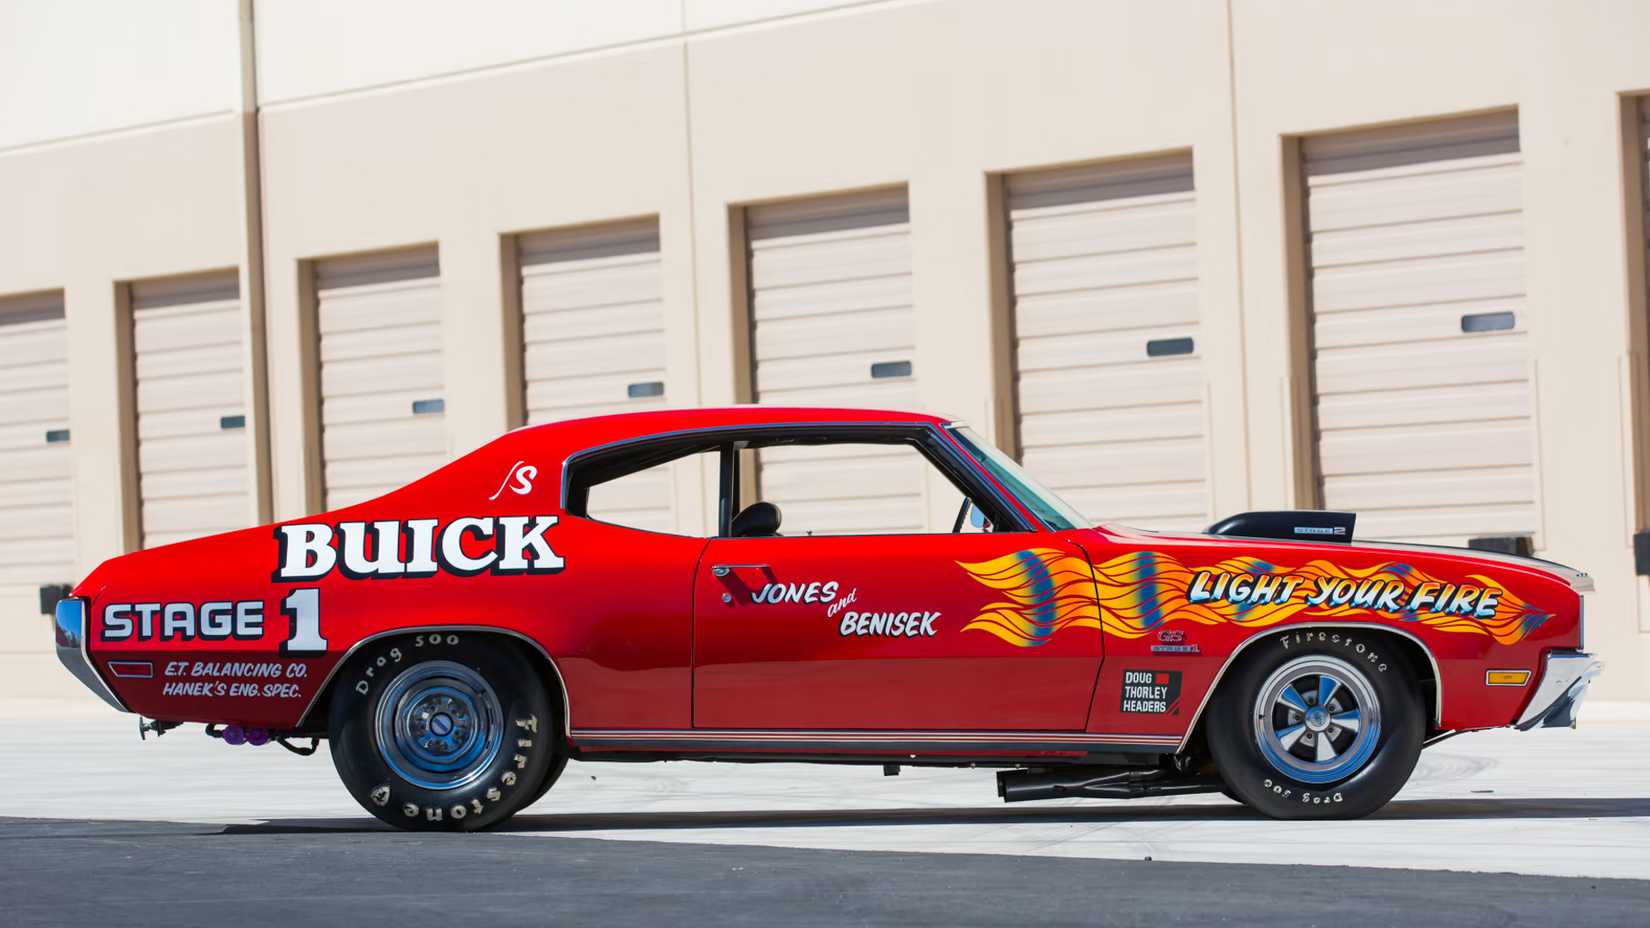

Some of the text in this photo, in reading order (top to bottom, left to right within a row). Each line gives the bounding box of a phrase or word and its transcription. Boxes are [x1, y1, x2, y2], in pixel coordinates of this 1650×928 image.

[273, 515, 565, 582] BUICK
[751, 581, 840, 605] JONES
[827, 588, 858, 618] and
[1188, 571, 1503, 619] LIGHT YOUR FIRE
[101, 588, 328, 657] STAGE 1
[839, 611, 943, 638] BENISEK
[415, 634, 460, 648] 500
[1280, 631, 1388, 672] Firestone
[164, 661, 308, 678] E.T. BALANCING CO.
[1125, 671, 1153, 684] DOUG
[162, 681, 227, 697] HANEK'S
[1124, 686, 1168, 699] THORLEY
[1122, 700, 1167, 713] HEADERS
[403, 714, 539, 822] Firestone
